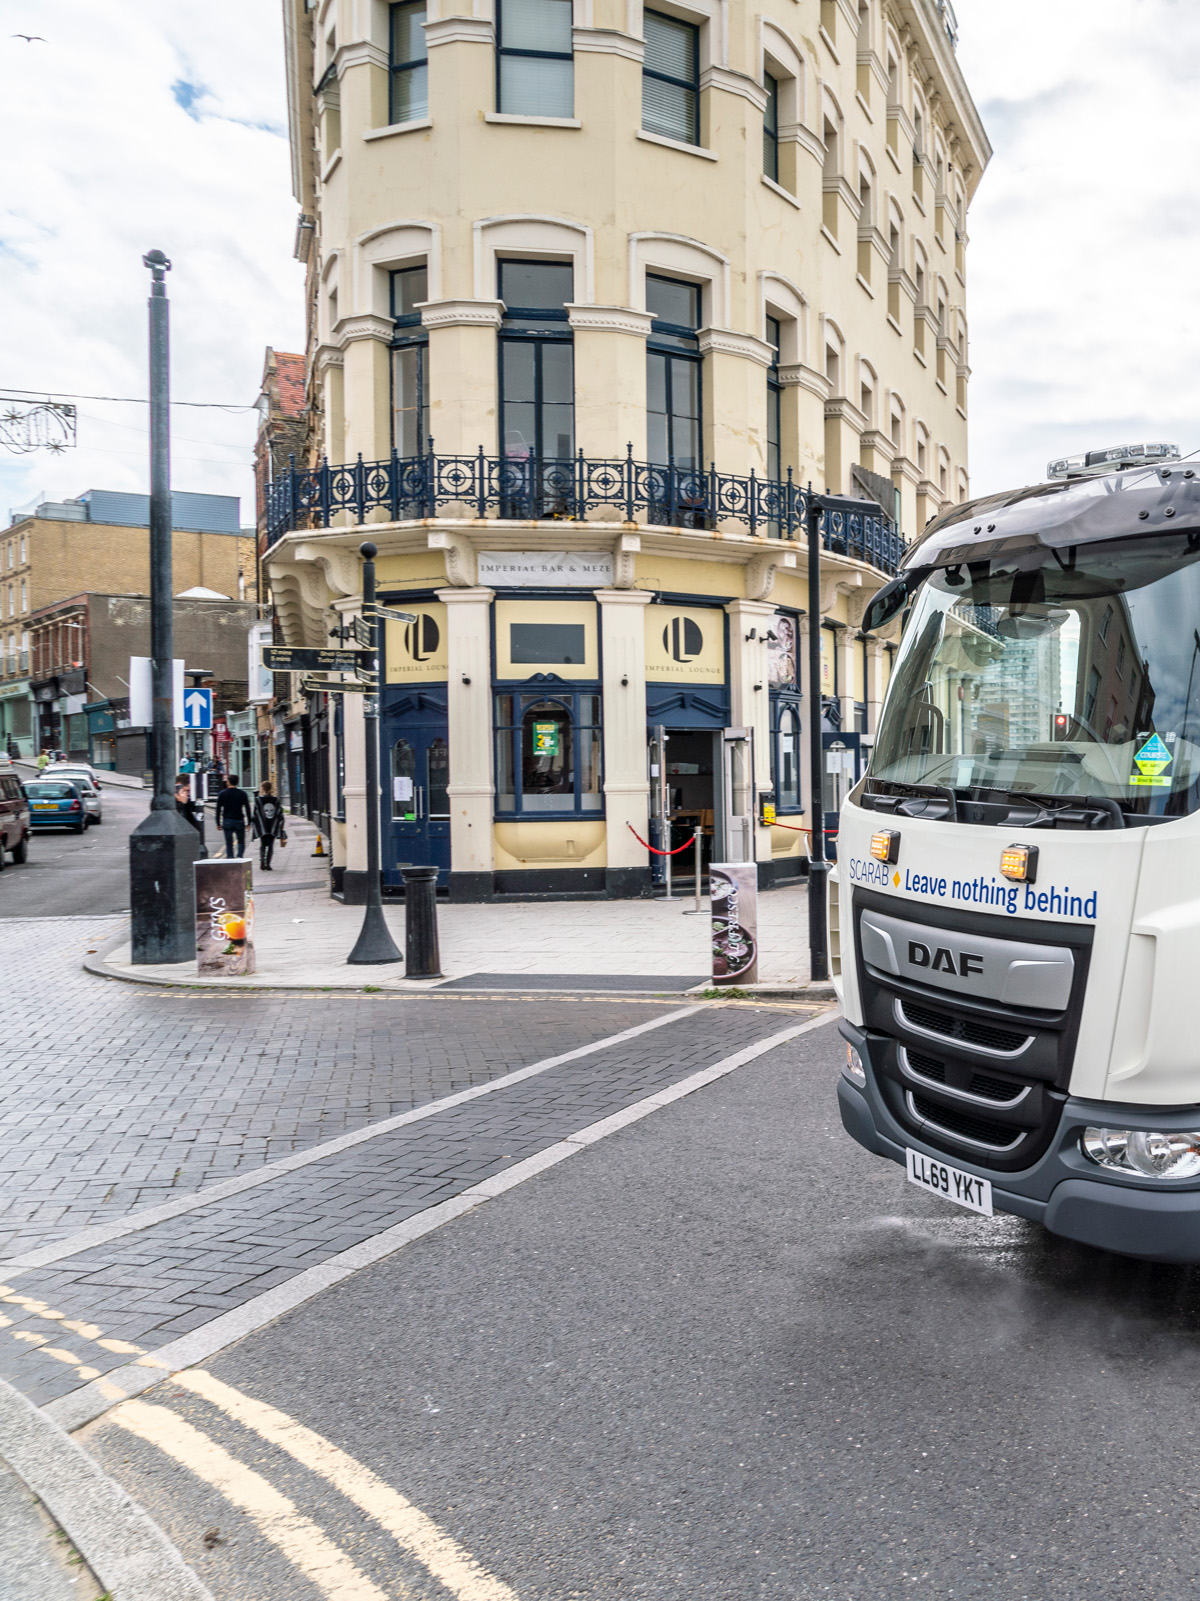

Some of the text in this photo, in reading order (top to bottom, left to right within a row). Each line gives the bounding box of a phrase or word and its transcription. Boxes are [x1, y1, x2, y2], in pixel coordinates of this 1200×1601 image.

[480, 564, 611, 573] IMPERIAL BAR & MEZE
[849, 858, 1098, 919] SCARAB Leave nothing behind
[209, 896, 230, 941] GINS
[908, 940, 984, 977] DAF
[912, 1154, 984, 1207] LL69 YKT
